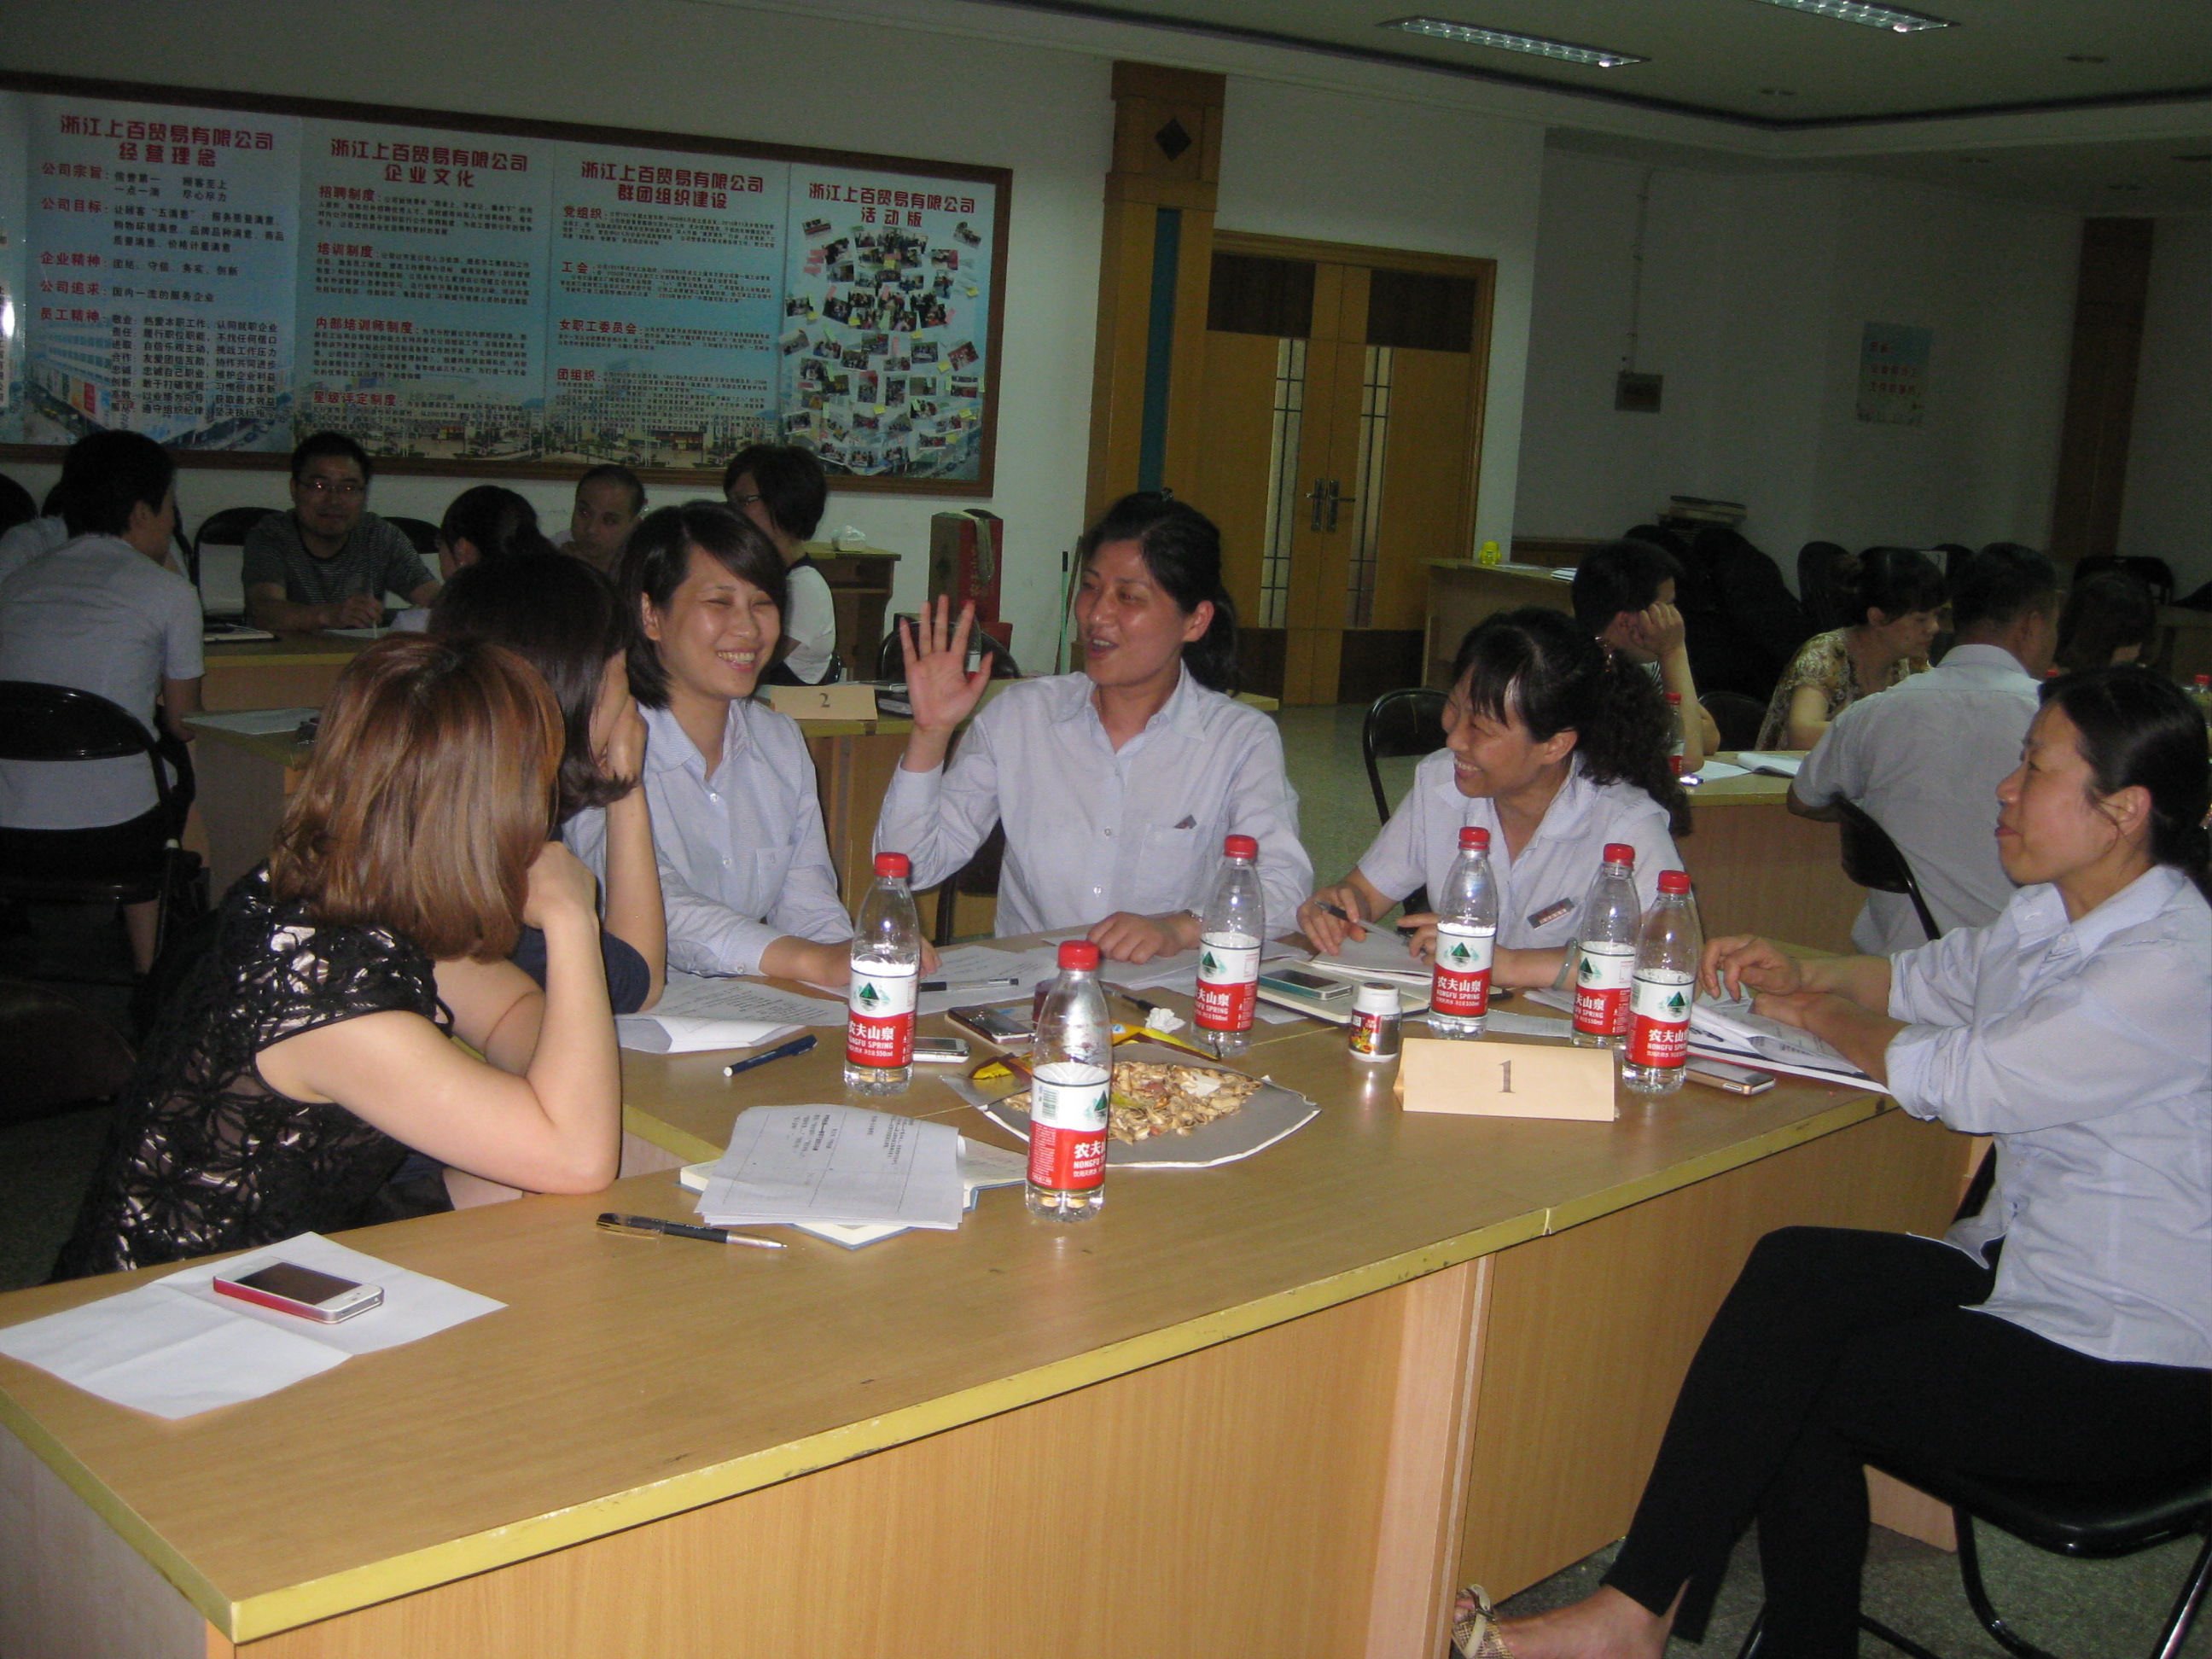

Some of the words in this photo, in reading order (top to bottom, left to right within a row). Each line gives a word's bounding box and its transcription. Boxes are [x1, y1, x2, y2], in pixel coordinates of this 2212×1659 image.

[60, 114, 274, 151] 浙江上百贸易有限公司
[119, 143, 217, 167] 经营理念
[330, 138, 528, 172] 浙江上百贸易有限公司
[384, 163, 475, 189] 企业文化
[581, 161, 764, 194] 浙江上百贸易有限公司
[115, 185, 160, 197] 一点一滴
[183, 189, 227, 202] 尽心尽力
[617, 183, 728, 210] 群团组织建设
[809, 182, 975, 213] 浙江上百贸易有限公司
[861, 207, 923, 228] 活动版
[818, 692, 831, 708] 2
[1437, 975, 1481, 992] 农夫山泉
[1196, 987, 1229, 1007] 夫山泉
[1206, 1005, 1229, 1015] SPRING
[1582, 1009, 1604, 1019] SPRING
[849, 1021, 894, 1041] 农夫山泉
[867, 1041, 894, 1050] SPRING
[1647, 1043, 1673, 1051] NONGFU
[1498, 1059, 1515, 1094] 1
[1073, 1158, 1100, 1169] NONGFU
